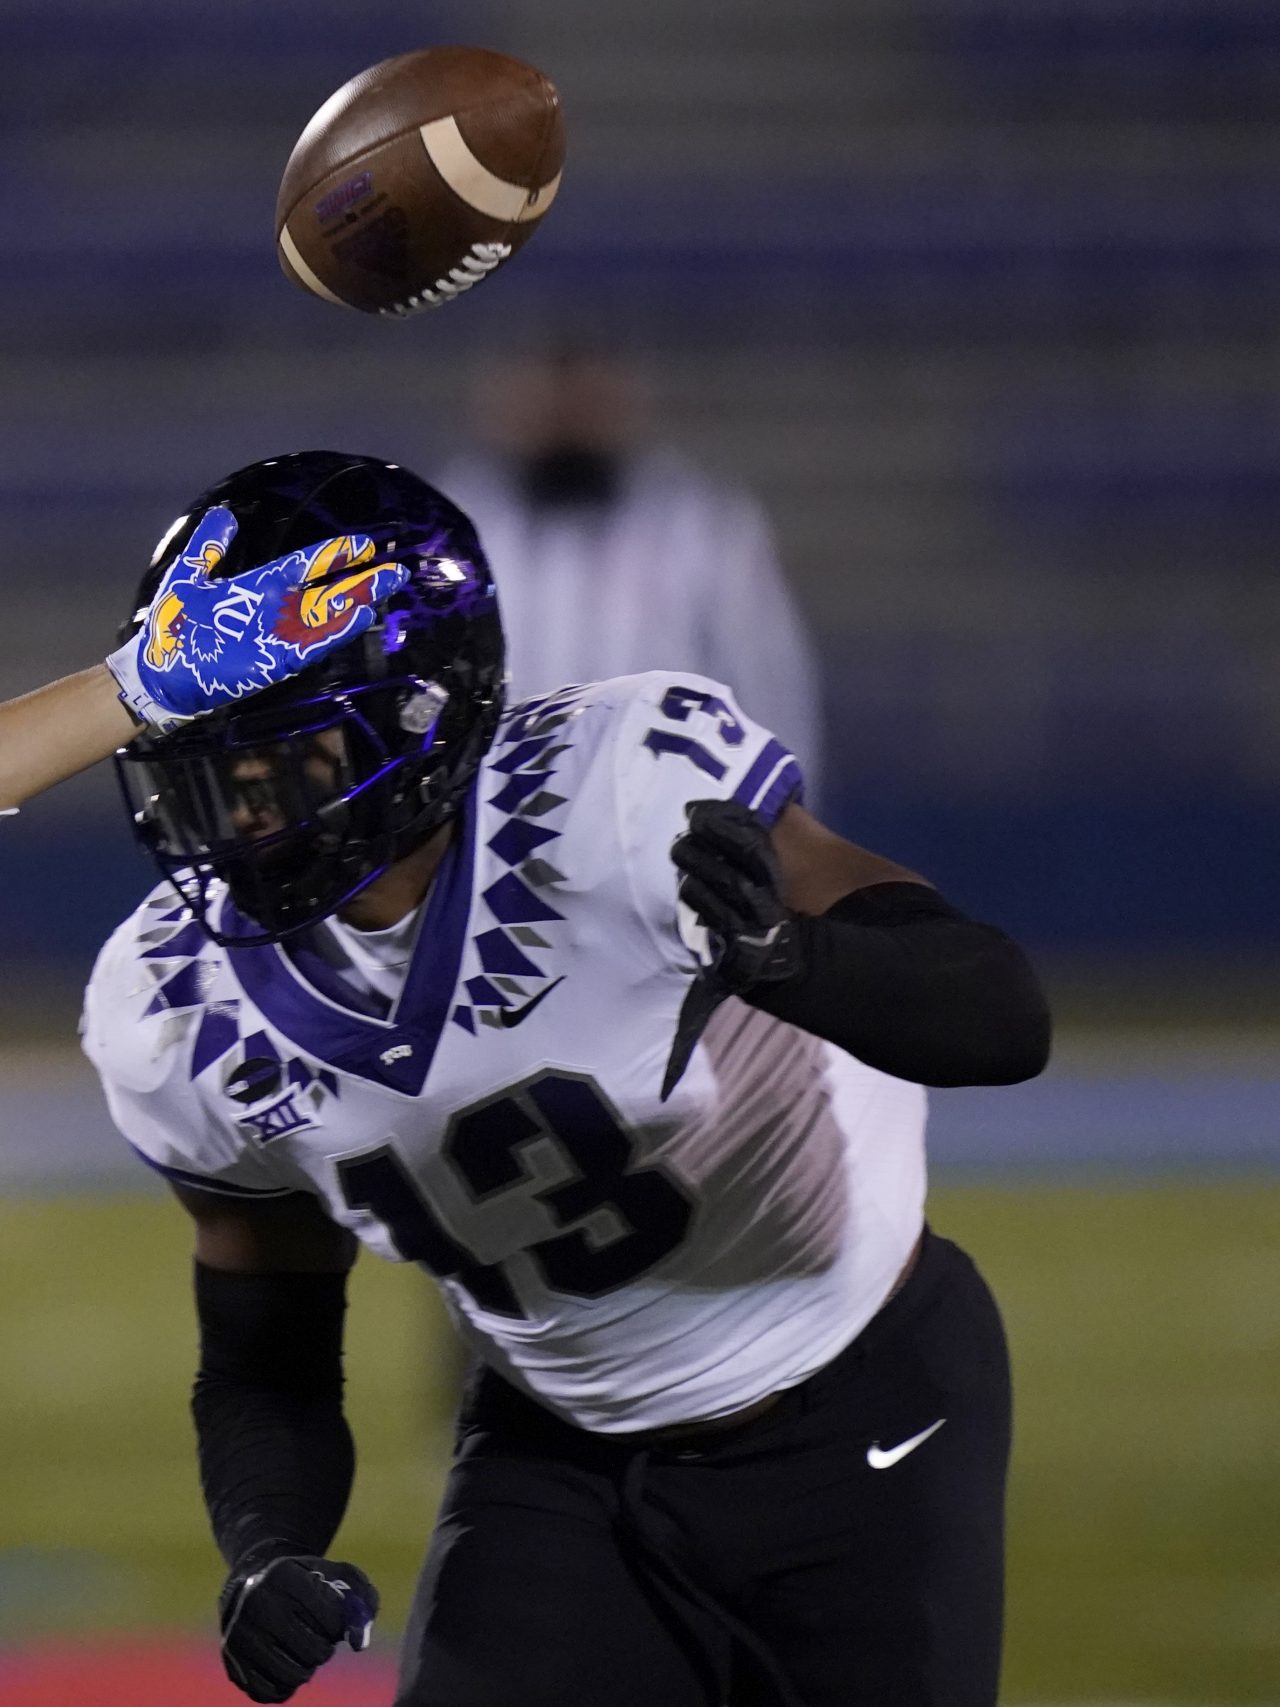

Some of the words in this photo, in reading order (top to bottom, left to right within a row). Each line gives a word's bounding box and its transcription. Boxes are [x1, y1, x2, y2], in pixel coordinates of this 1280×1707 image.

[212, 583, 265, 642] KU
[642, 685, 746, 782] 13
[325, 1066, 700, 1322] 13
